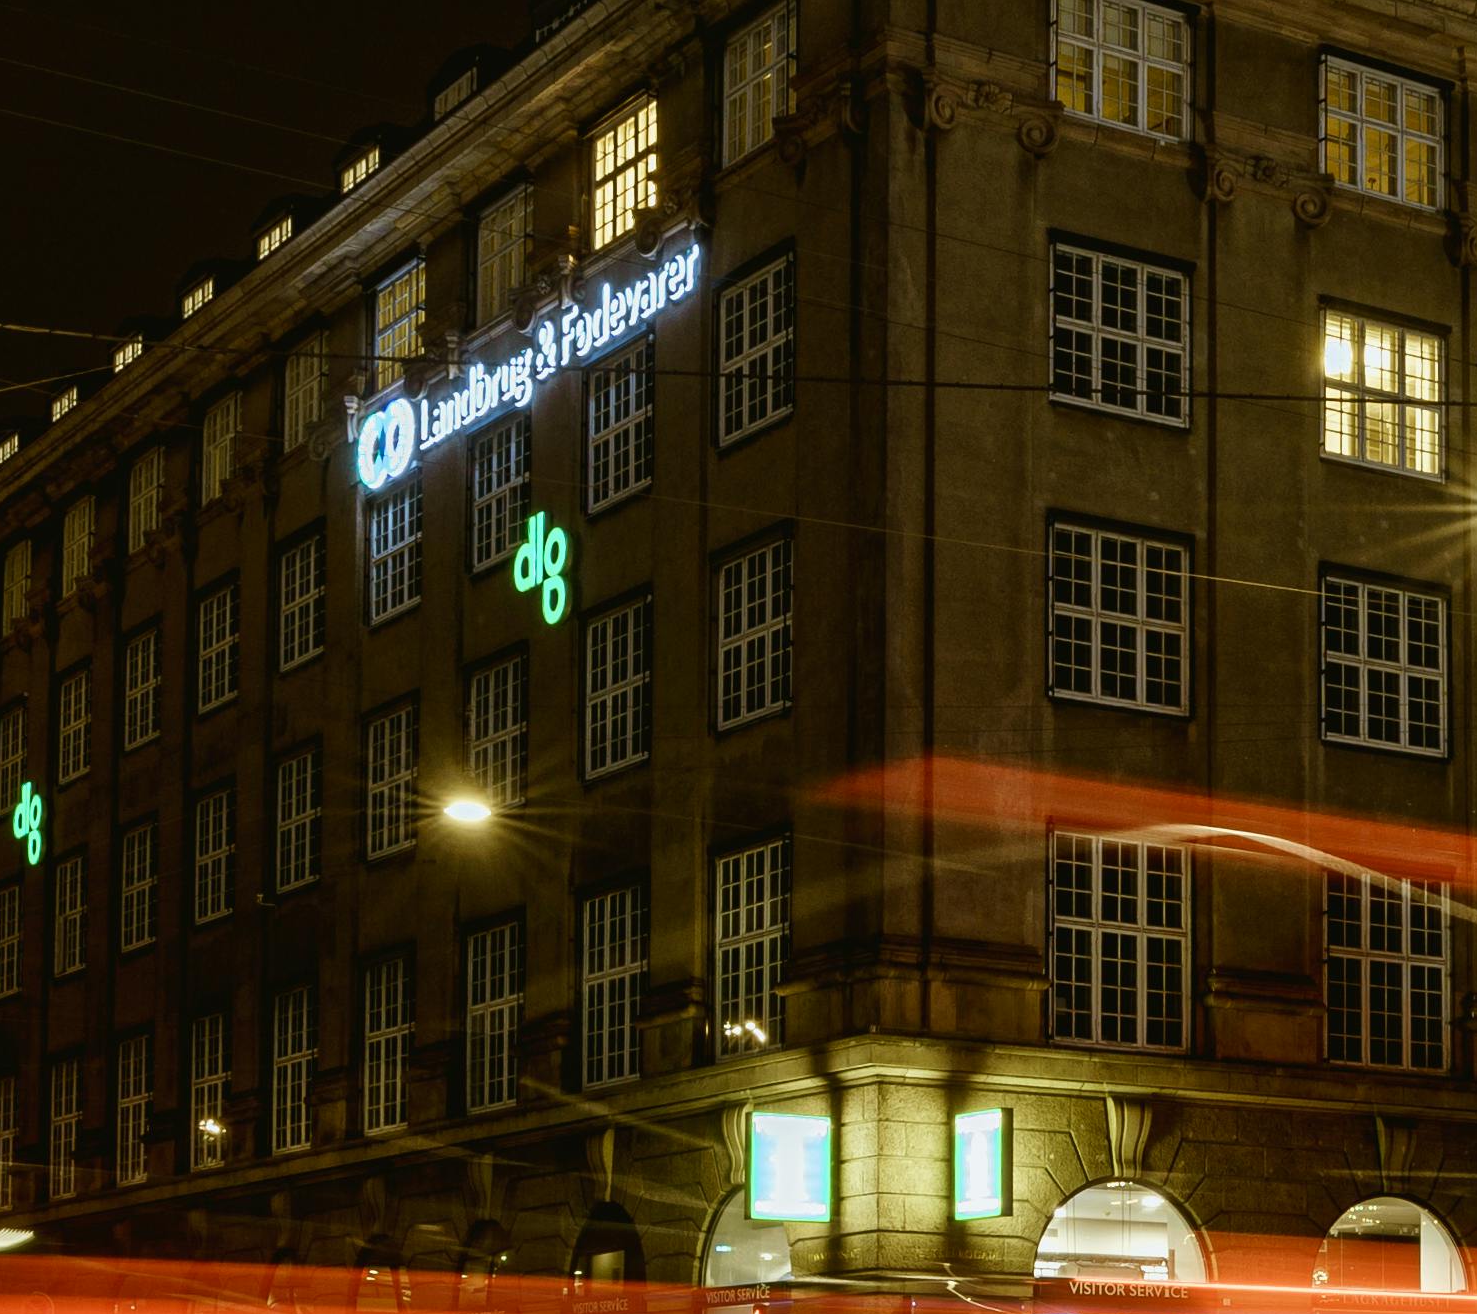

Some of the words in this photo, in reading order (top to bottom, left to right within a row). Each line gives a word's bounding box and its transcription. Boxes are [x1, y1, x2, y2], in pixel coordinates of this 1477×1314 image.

[419, 347, 533, 450] Landbrug
[535, 319, 557, 377] &
[1069, 1281, 1126, 1296] VISITOR
[706, 1290, 736, 1304] VISITOR
